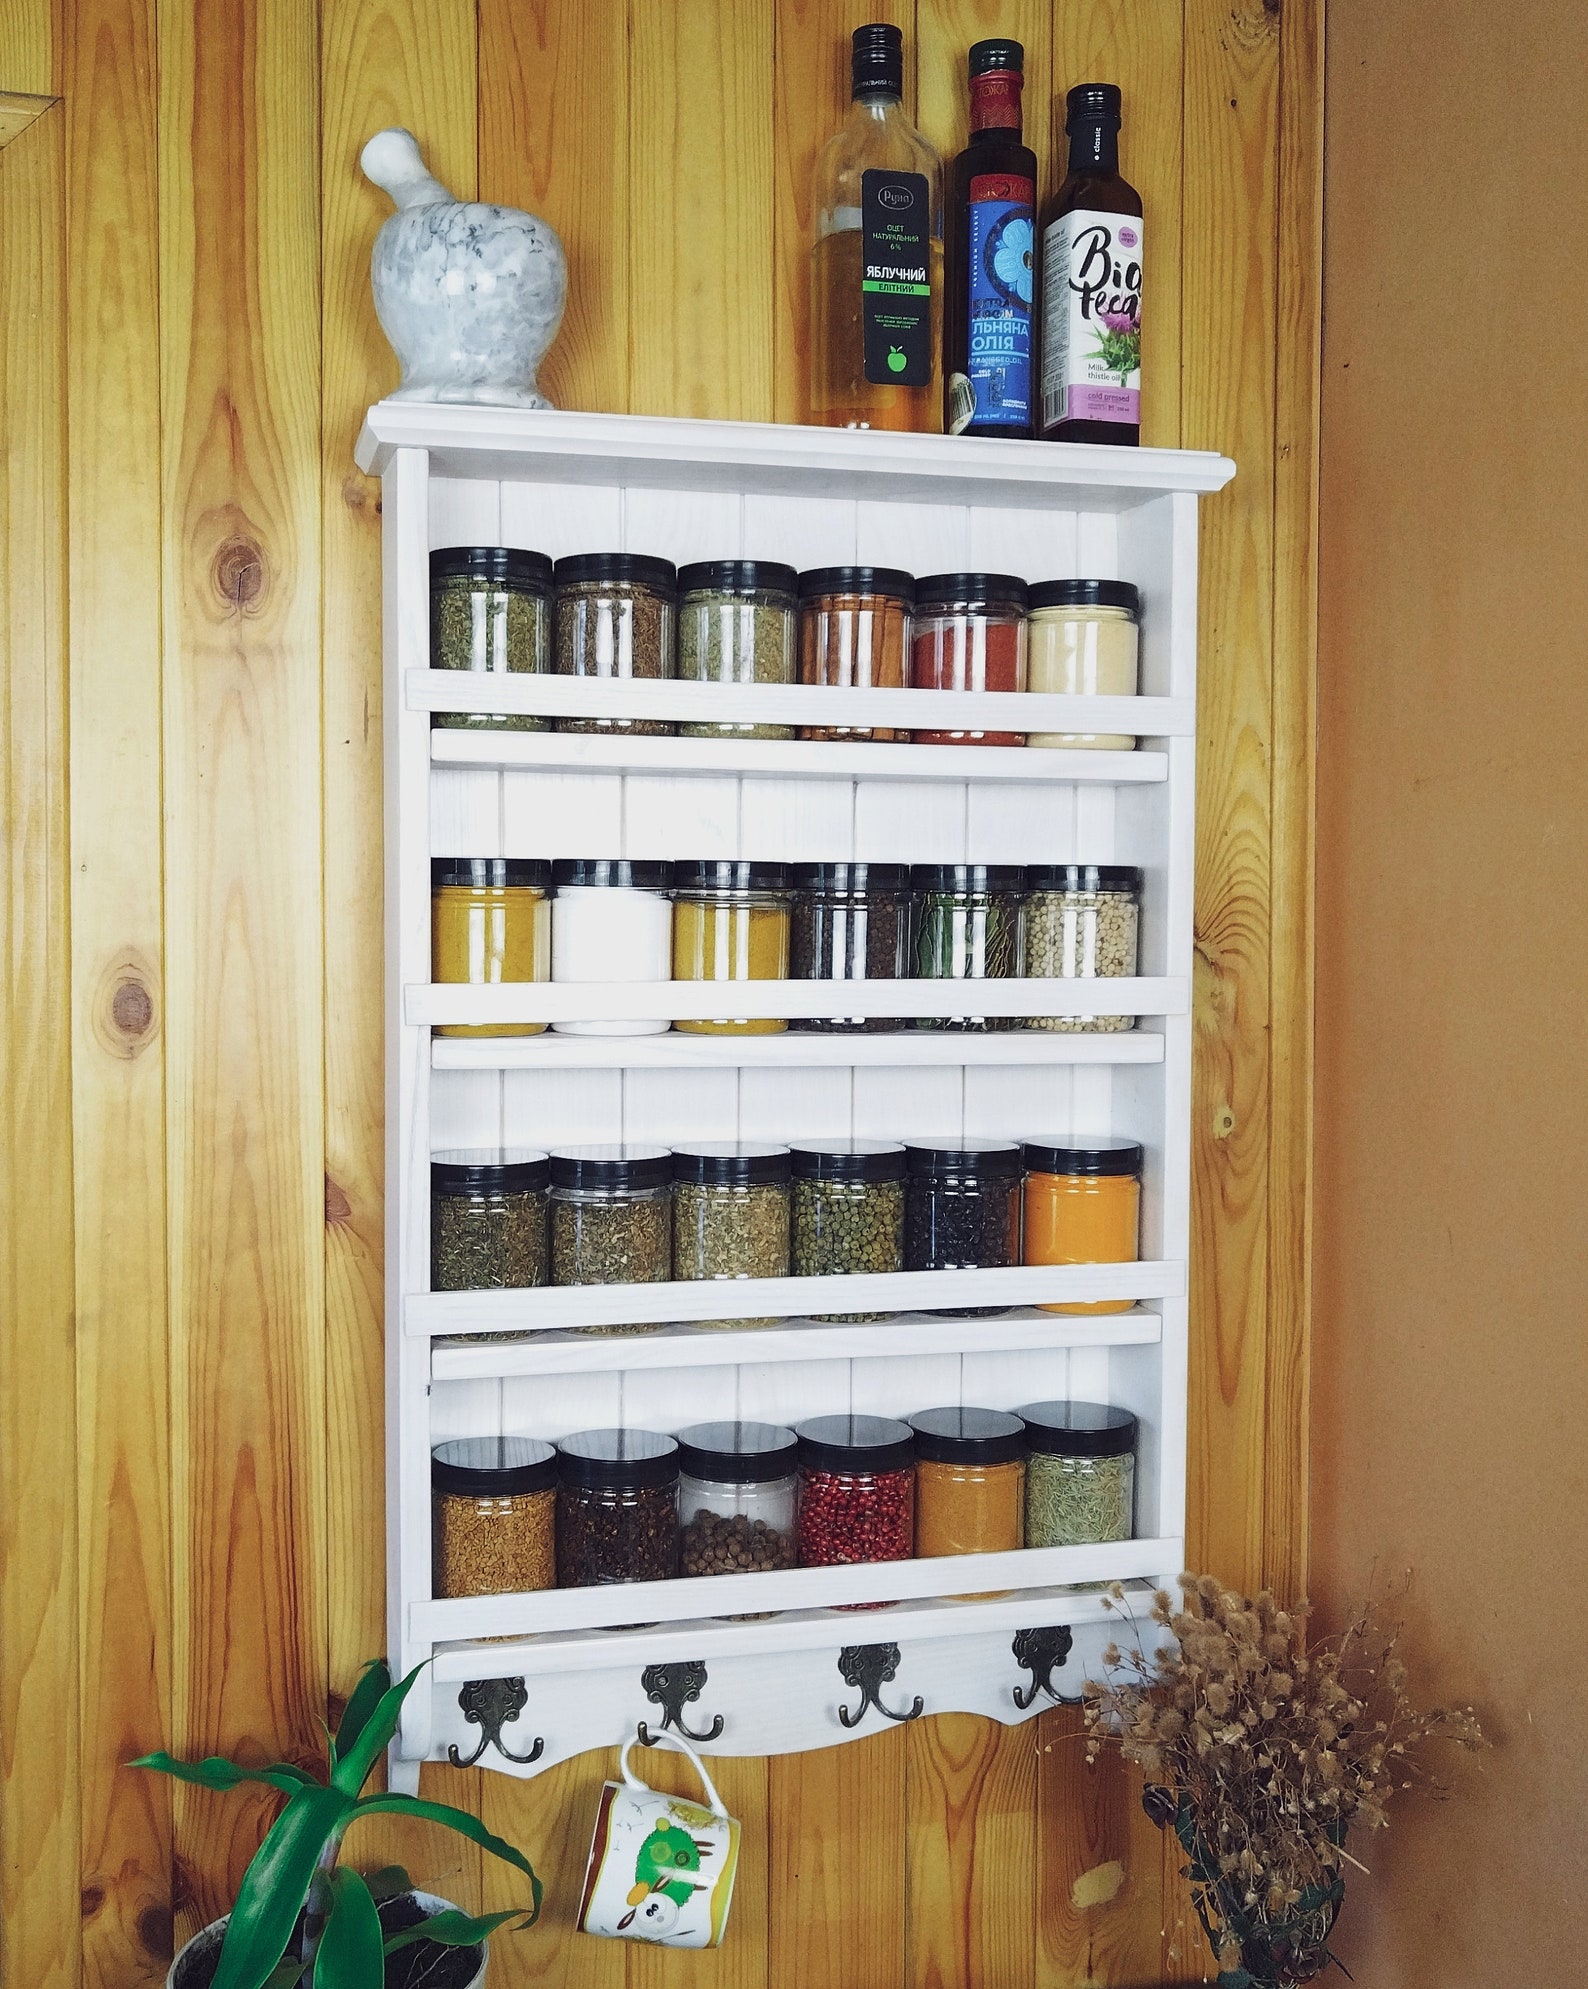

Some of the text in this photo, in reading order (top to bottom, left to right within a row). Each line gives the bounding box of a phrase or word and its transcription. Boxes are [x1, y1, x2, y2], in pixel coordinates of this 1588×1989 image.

[1093, 127, 1101, 153] classic
[886, 224, 904, 233] ОЦЕТ
[872, 232, 920, 242] НАТУРАЛЬНИЙ
[866, 265, 926, 282] ЯБЛУЧНИЙ
[878, 283, 915, 293] ЕЛІТНИЙ
[1078, 280, 1139, 321] teca
[973, 321, 1028, 337] ЛЬНЯНА
[972, 335, 1014, 351] ОЛІЯ
[1088, 363, 1104, 371] Milk
[1088, 372, 1110, 380] thistle
[1088, 392, 1129, 402] cold pressed
